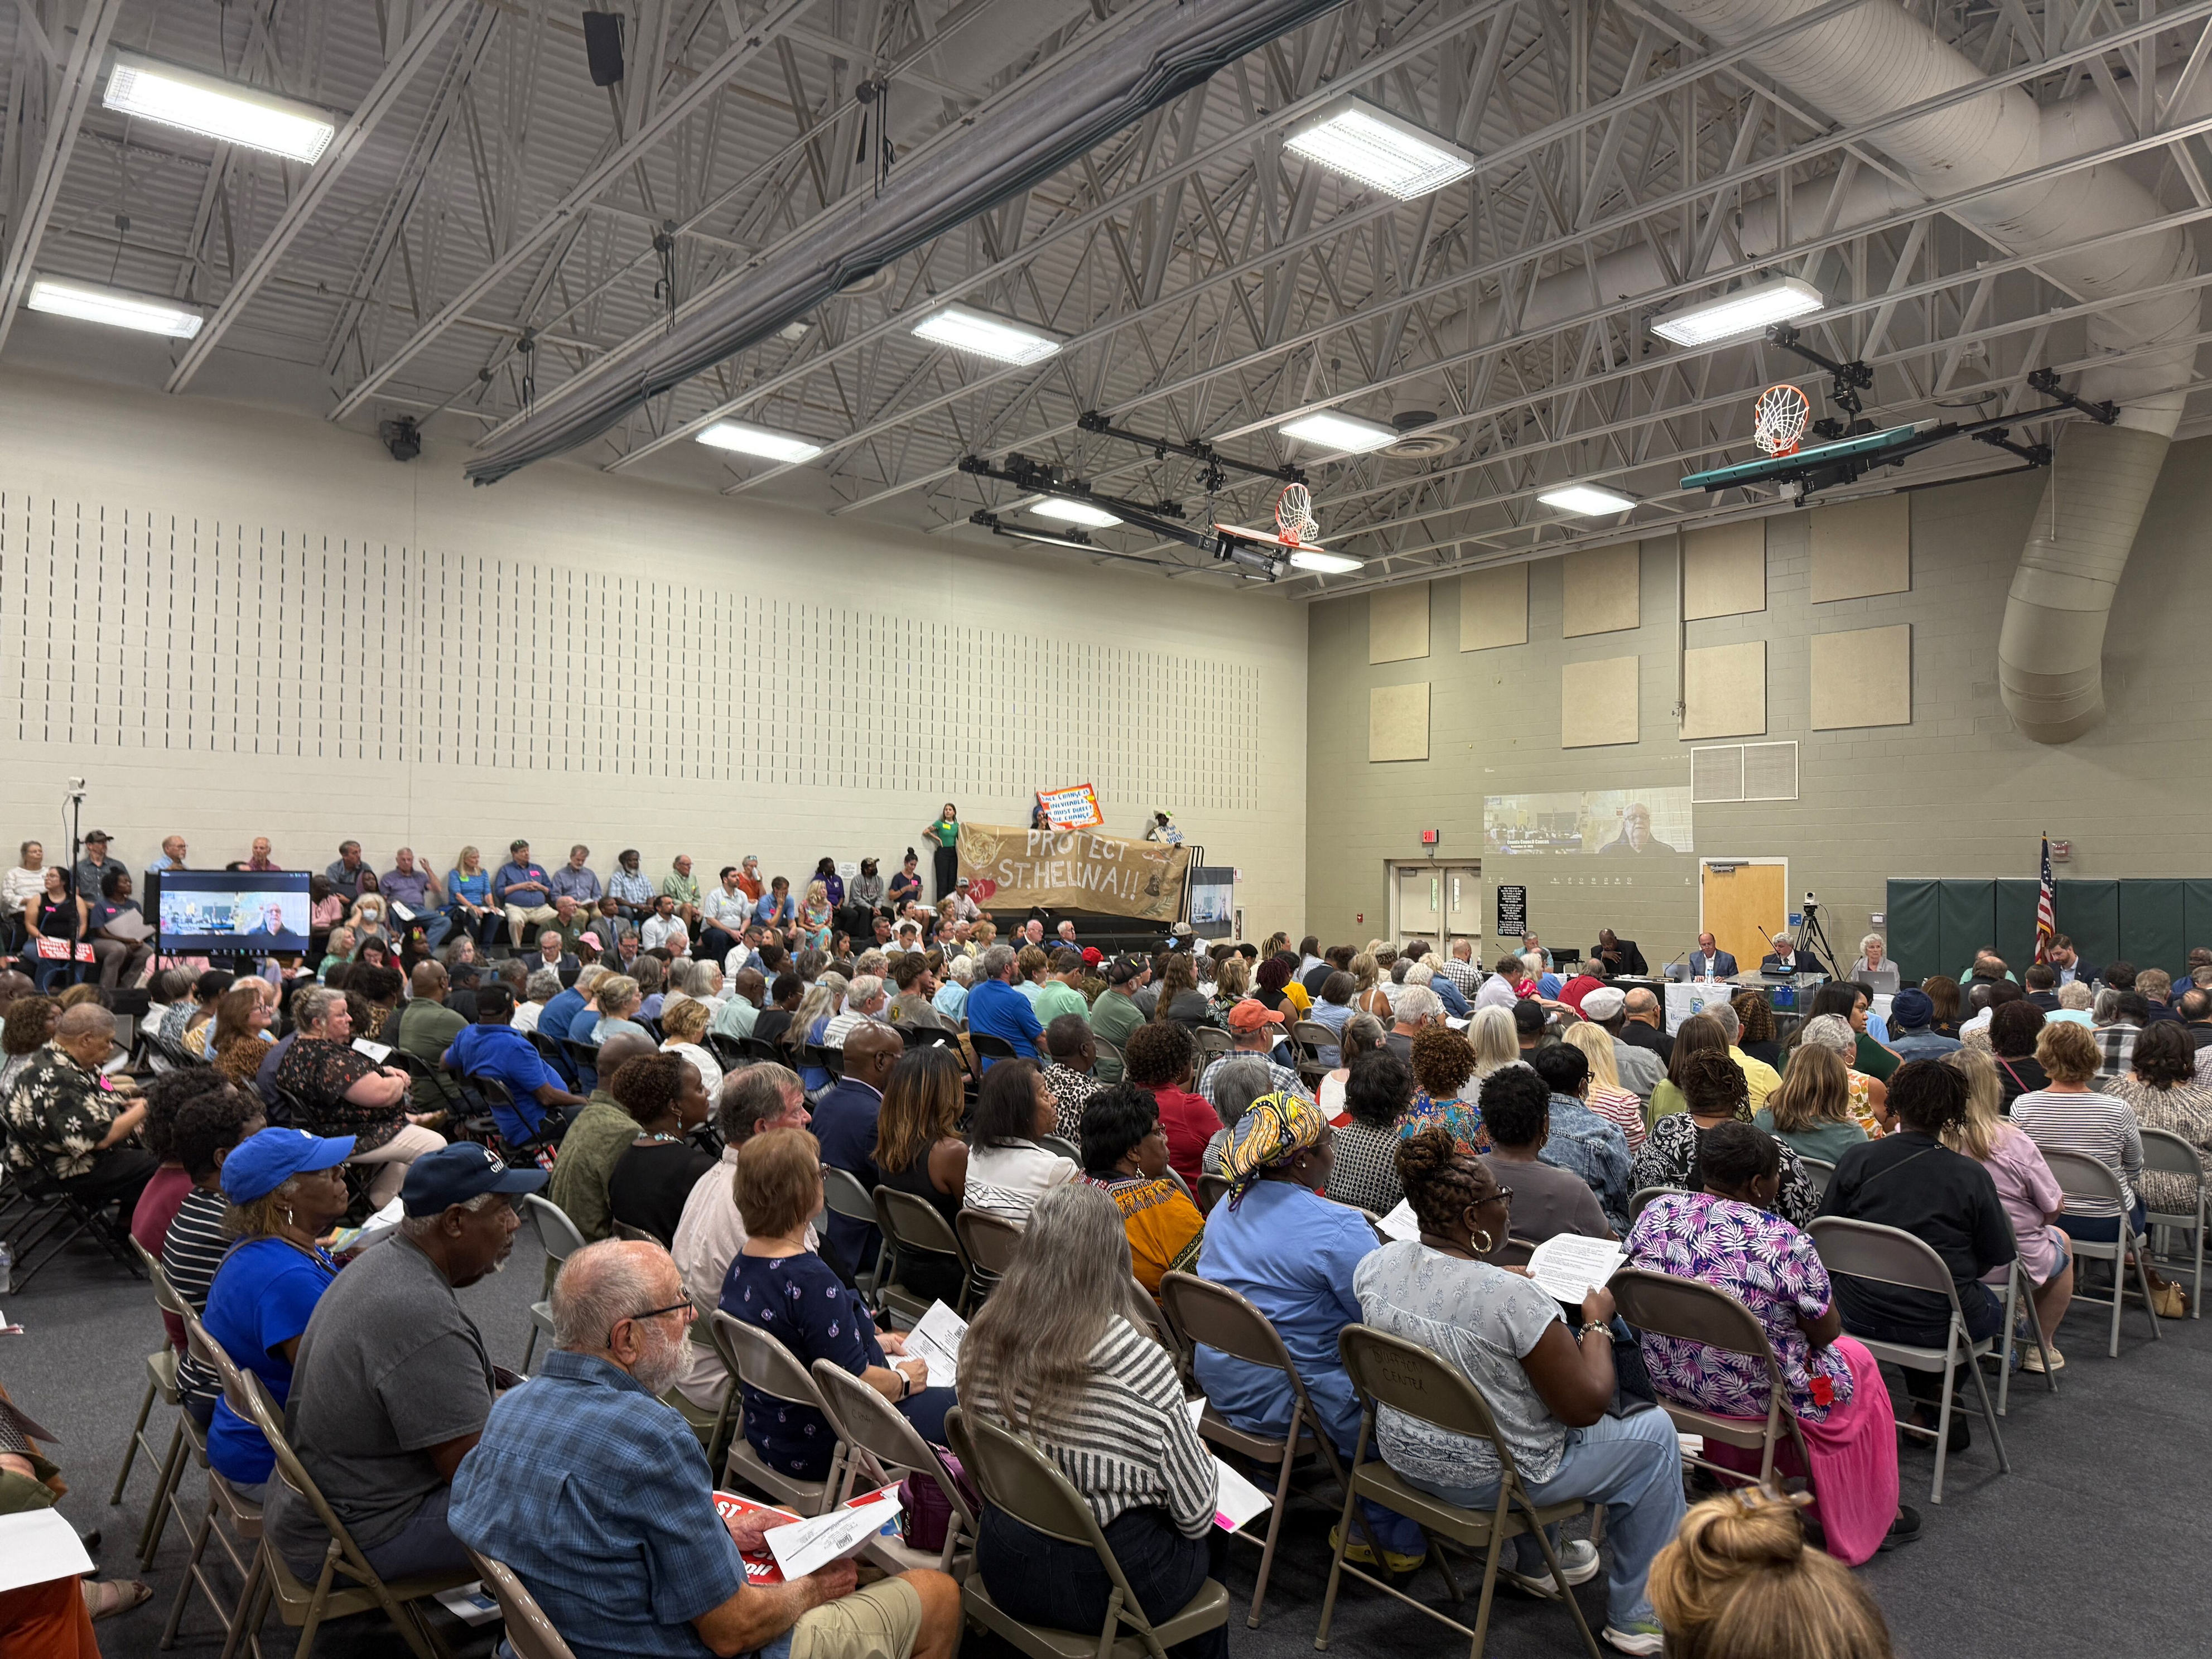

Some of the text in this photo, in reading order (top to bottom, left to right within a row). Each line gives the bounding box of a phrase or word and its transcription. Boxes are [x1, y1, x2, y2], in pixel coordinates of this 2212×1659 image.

[1058, 791, 1082, 800] CHANGE
[1025, 828, 1130, 862] PROTECT
[1382, 1368, 1428, 1394] CENTER
